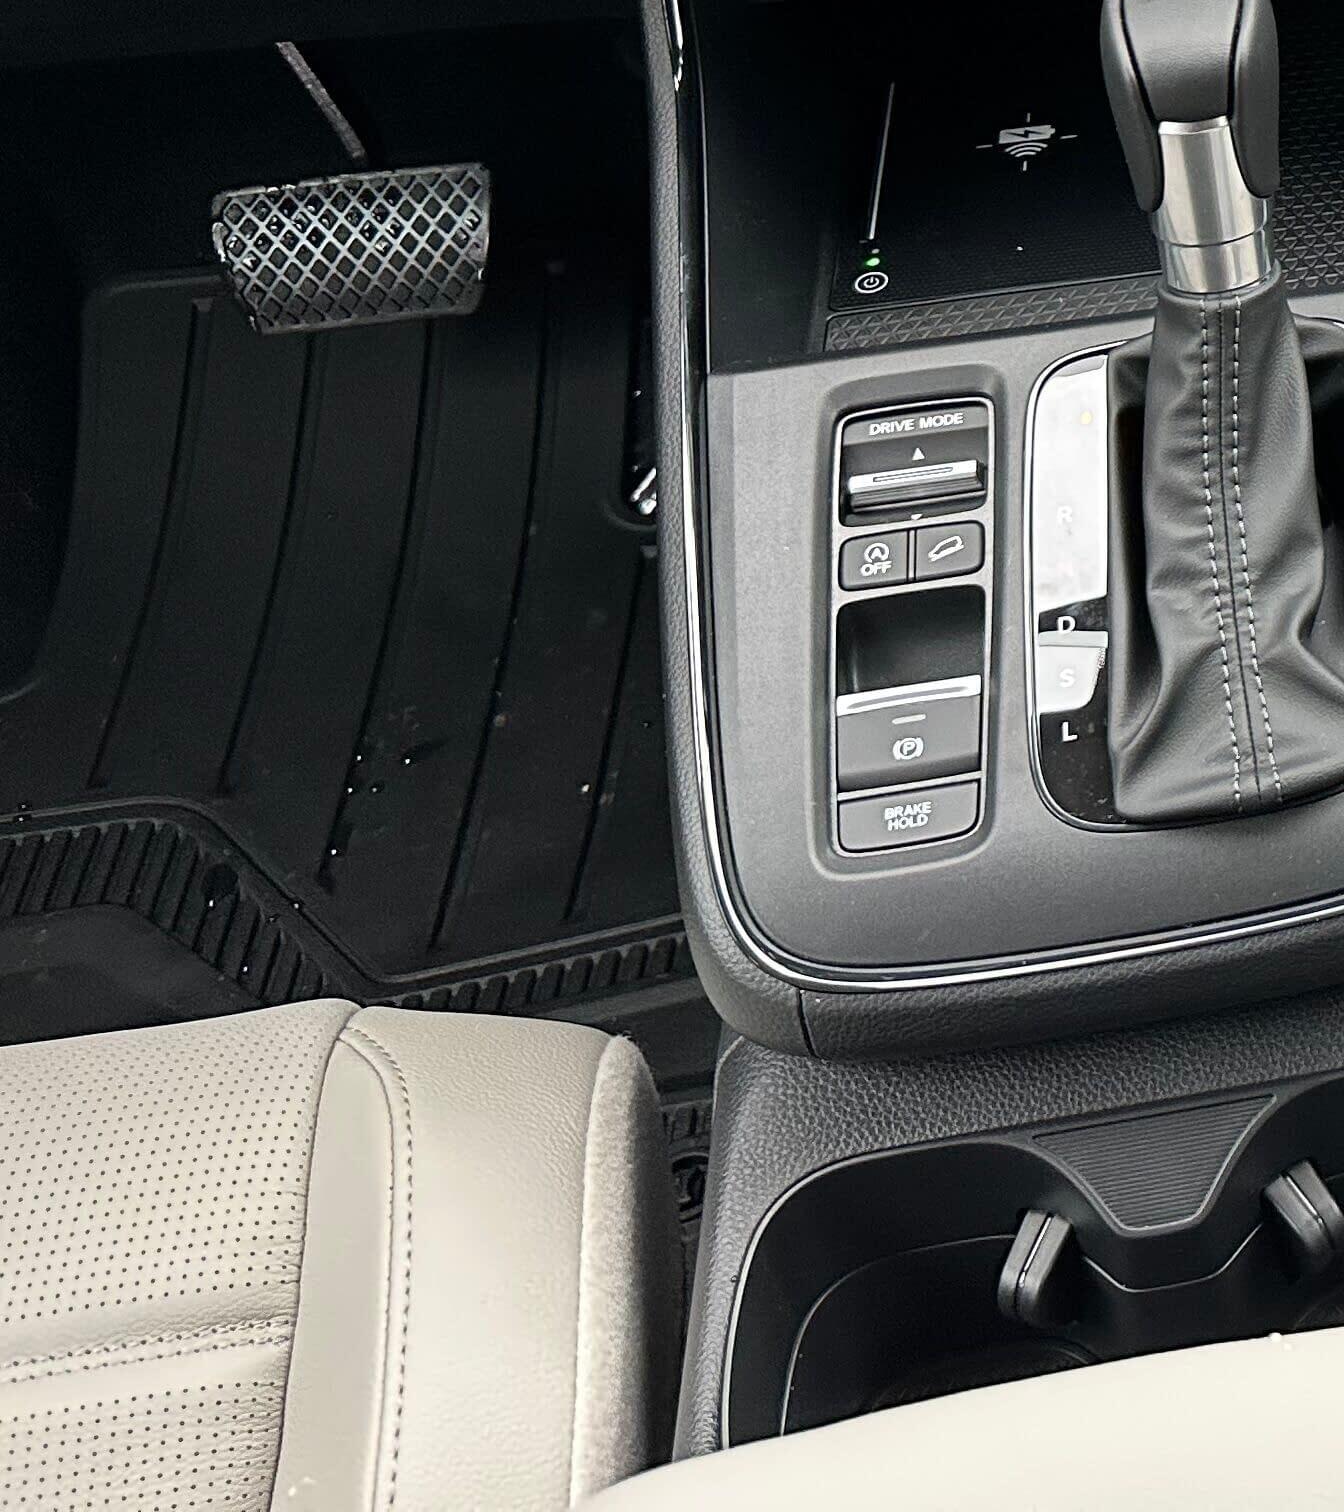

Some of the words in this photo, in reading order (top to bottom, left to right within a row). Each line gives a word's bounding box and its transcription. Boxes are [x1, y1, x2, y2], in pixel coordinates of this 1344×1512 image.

[869, 418, 914, 436] DRIVE
[920, 412, 964, 427] MODE
[1057, 506, 1072, 523] R
[861, 560, 891, 576] OFF
[1057, 615, 1076, 632] D
[1060, 669, 1075, 686] S
[1061, 722, 1078, 742] L
[884, 802, 931, 818] BRAKE
[887, 814, 928, 830] HOLD
